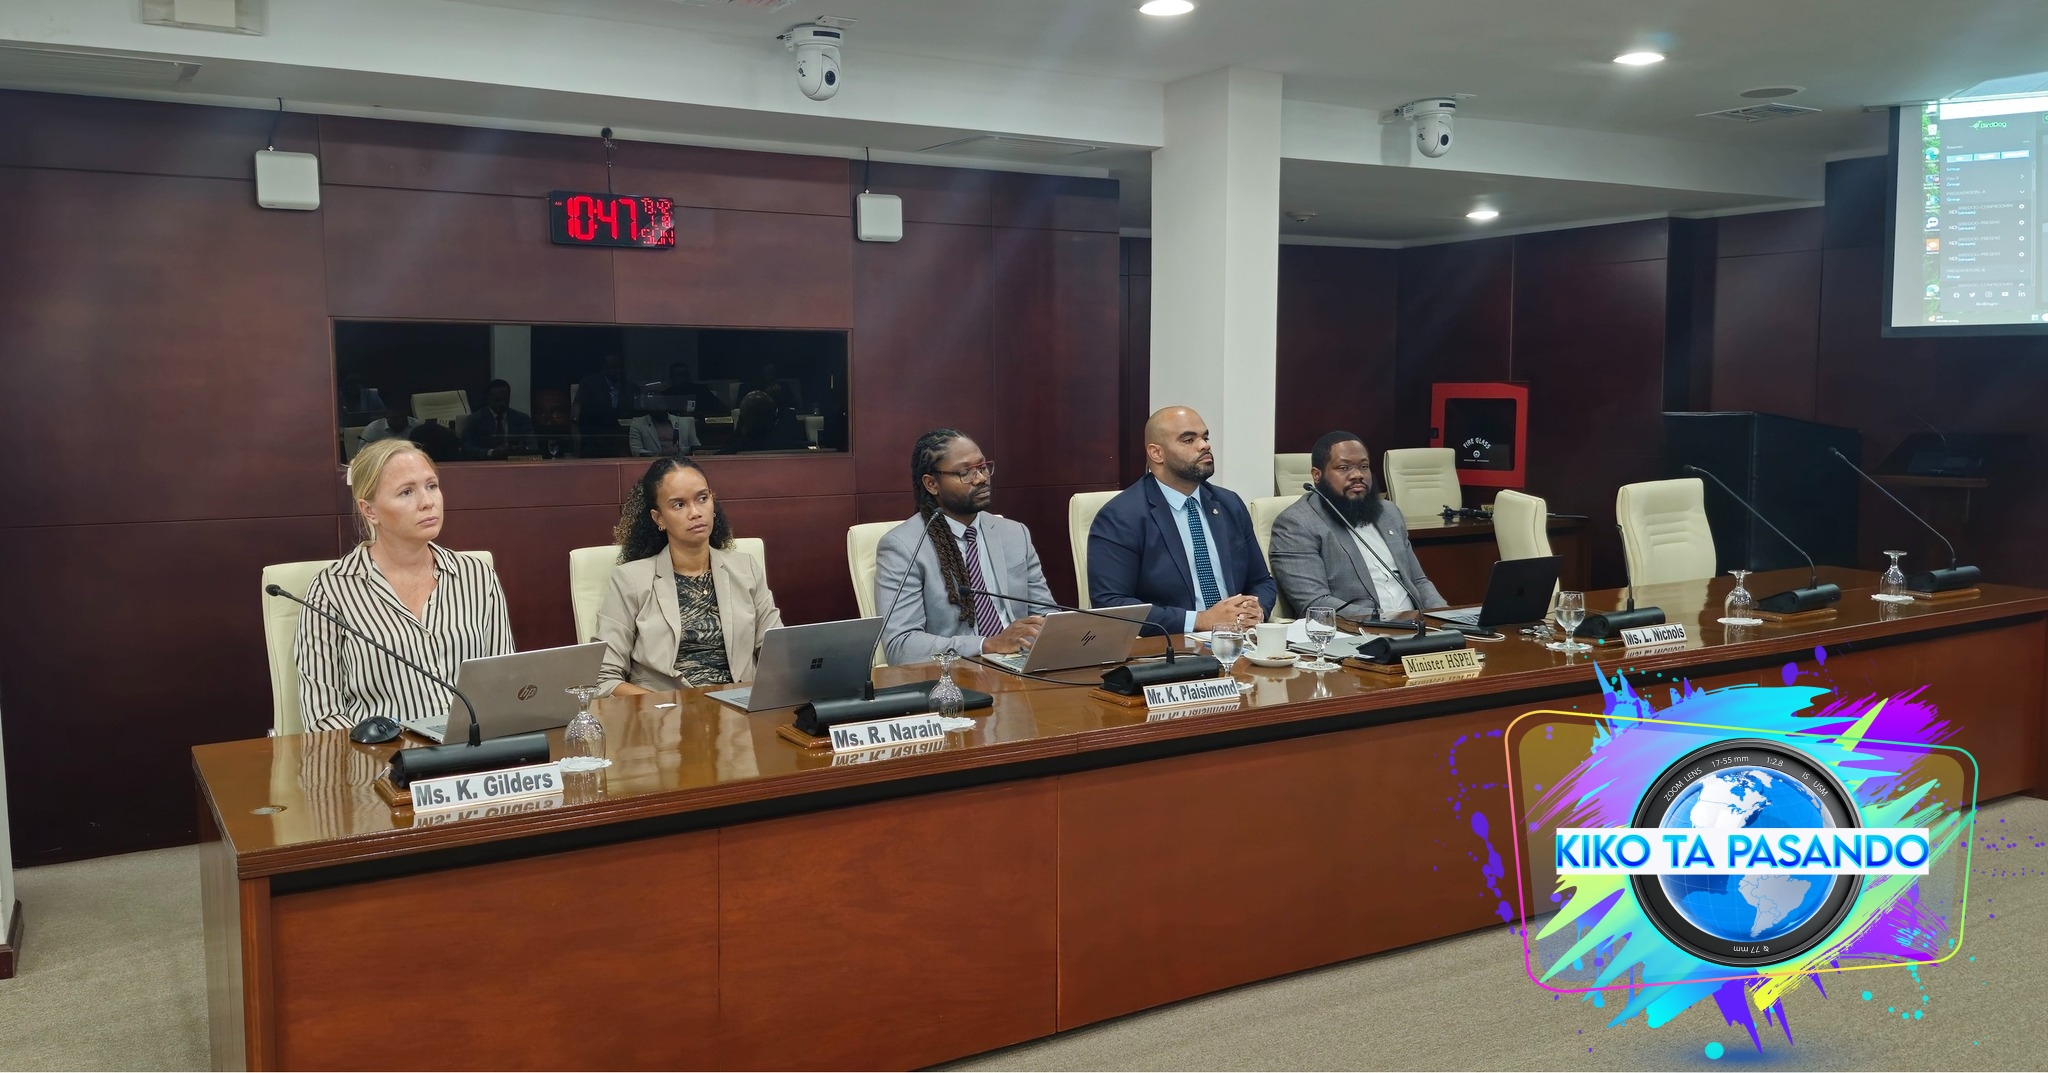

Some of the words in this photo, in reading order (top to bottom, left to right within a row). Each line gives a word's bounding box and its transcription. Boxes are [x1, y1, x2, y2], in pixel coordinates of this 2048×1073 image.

[1980, 121, 2007, 129] BirdDog
[567, 196, 637, 241] 10:47
[1463, 437, 1474, 449] FIRE
[1475, 437, 1491, 449] GLASS
[1624, 632, 1642, 645] Ms.
[1641, 630, 1652, 643] L.
[1652, 626, 1685, 642] Nichols
[1406, 657, 1444, 673] Minister
[1445, 652, 1475, 668] HSPEI
[519, 686, 537, 700] hp
[1146, 689, 1164, 705] Mr.
[1165, 687, 1179, 702] K.
[1179, 680, 1238, 700] Plaisimond
[834, 729, 864, 748] Ms.
[867, 726, 886, 744] R.
[889, 719, 943, 741] Narain
[414, 784, 451, 806] Ms.
[456, 779, 478, 801] K.
[483, 772, 553, 797] Gilders
